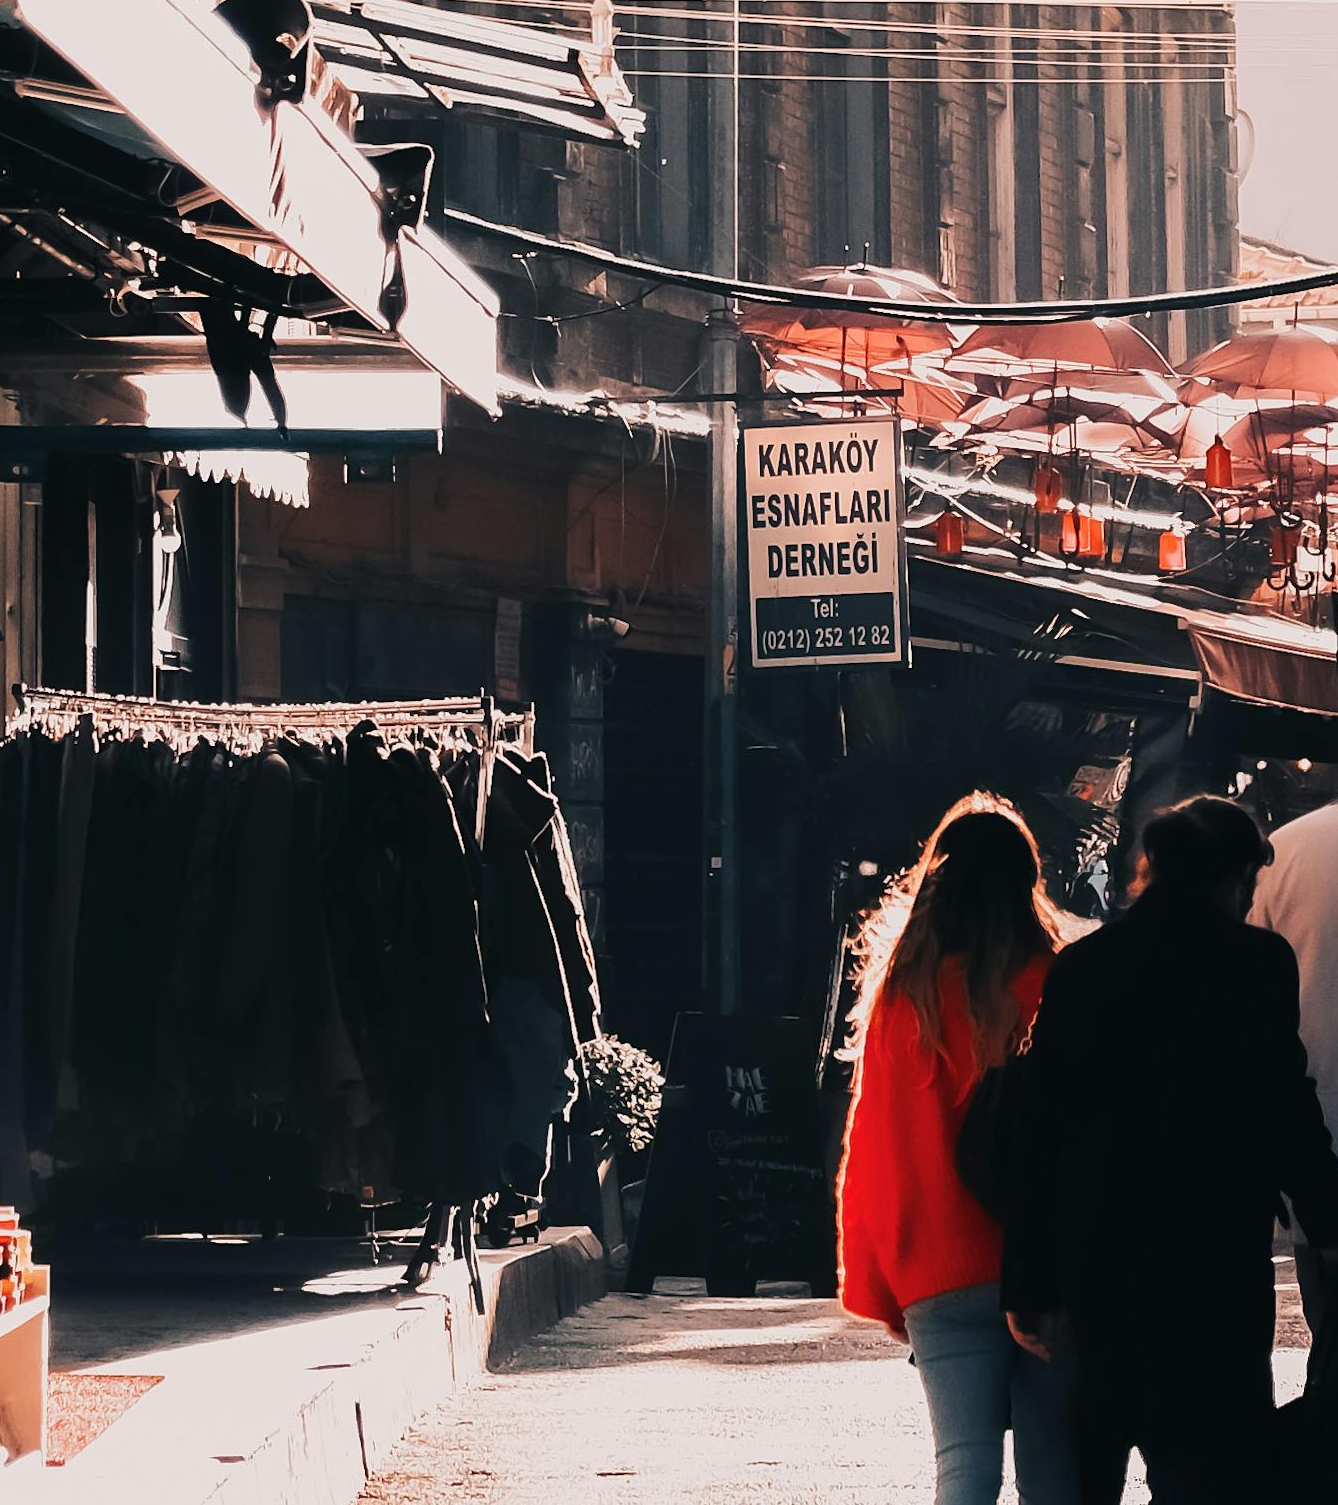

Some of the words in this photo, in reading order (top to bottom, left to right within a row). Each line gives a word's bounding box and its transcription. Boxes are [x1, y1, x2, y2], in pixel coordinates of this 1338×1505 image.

[758, 432, 879, 477] KARAKÖY
[751, 489, 891, 529] ESNAFLARI
[767, 532, 878, 578] DERNEĞİ
[810, 598, 839, 618] Tel:
[762, 629, 811, 655] (0212)
[815, 627, 843, 648] 252
[848, 626, 867, 646] 12
[871, 625, 891, 645] 82
